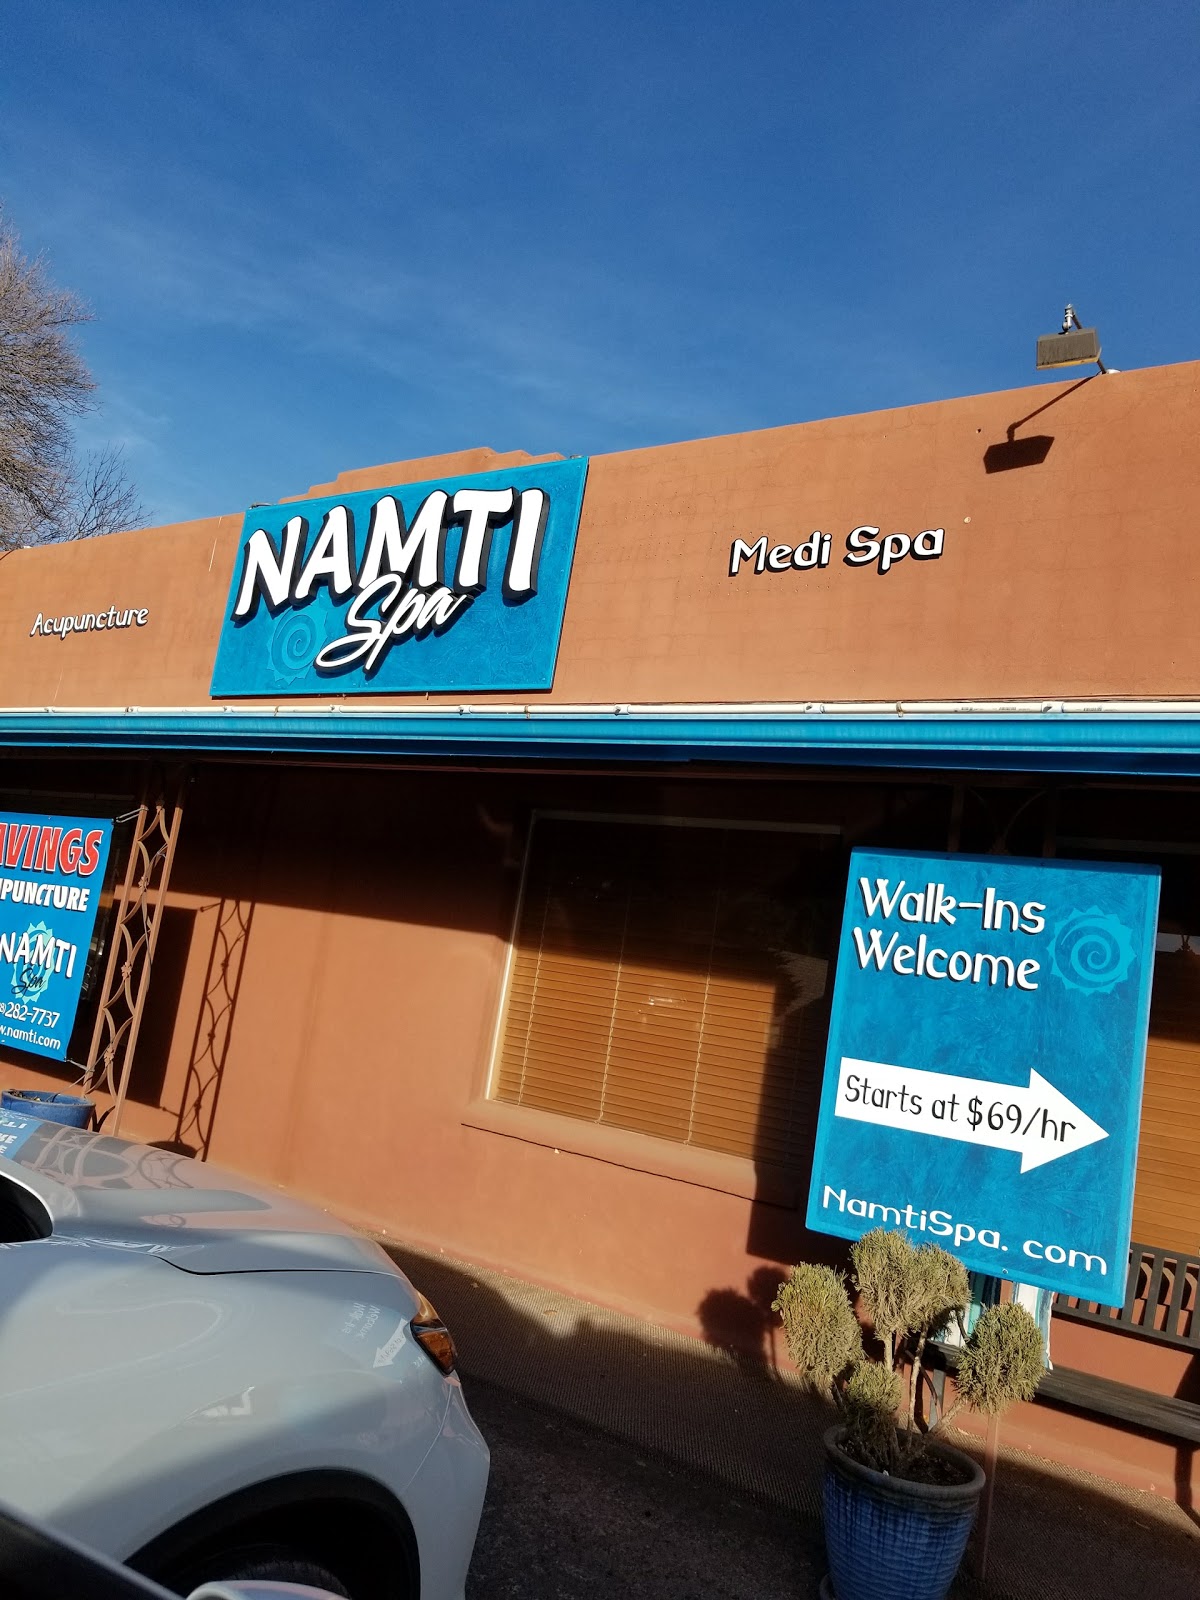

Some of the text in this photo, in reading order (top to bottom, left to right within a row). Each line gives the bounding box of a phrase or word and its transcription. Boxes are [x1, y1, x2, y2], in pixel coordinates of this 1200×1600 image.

[232, 487, 550, 621] NAMTI
[728, 525, 945, 577] Medi Spa
[30, 605, 149, 640] Acupuncture
[312, 572, 468, 674] Spa
[0, 877, 91, 912] PUNCTURE
[859, 877, 1046, 935] Walk-Ins
[0, 931, 77, 979] NAMTI
[852, 926, 1041, 991] Welcome
[845, 1074, 1077, 1142] Starts at $69/hr
[822, 1184, 1108, 1276] NamtiSpa. com
